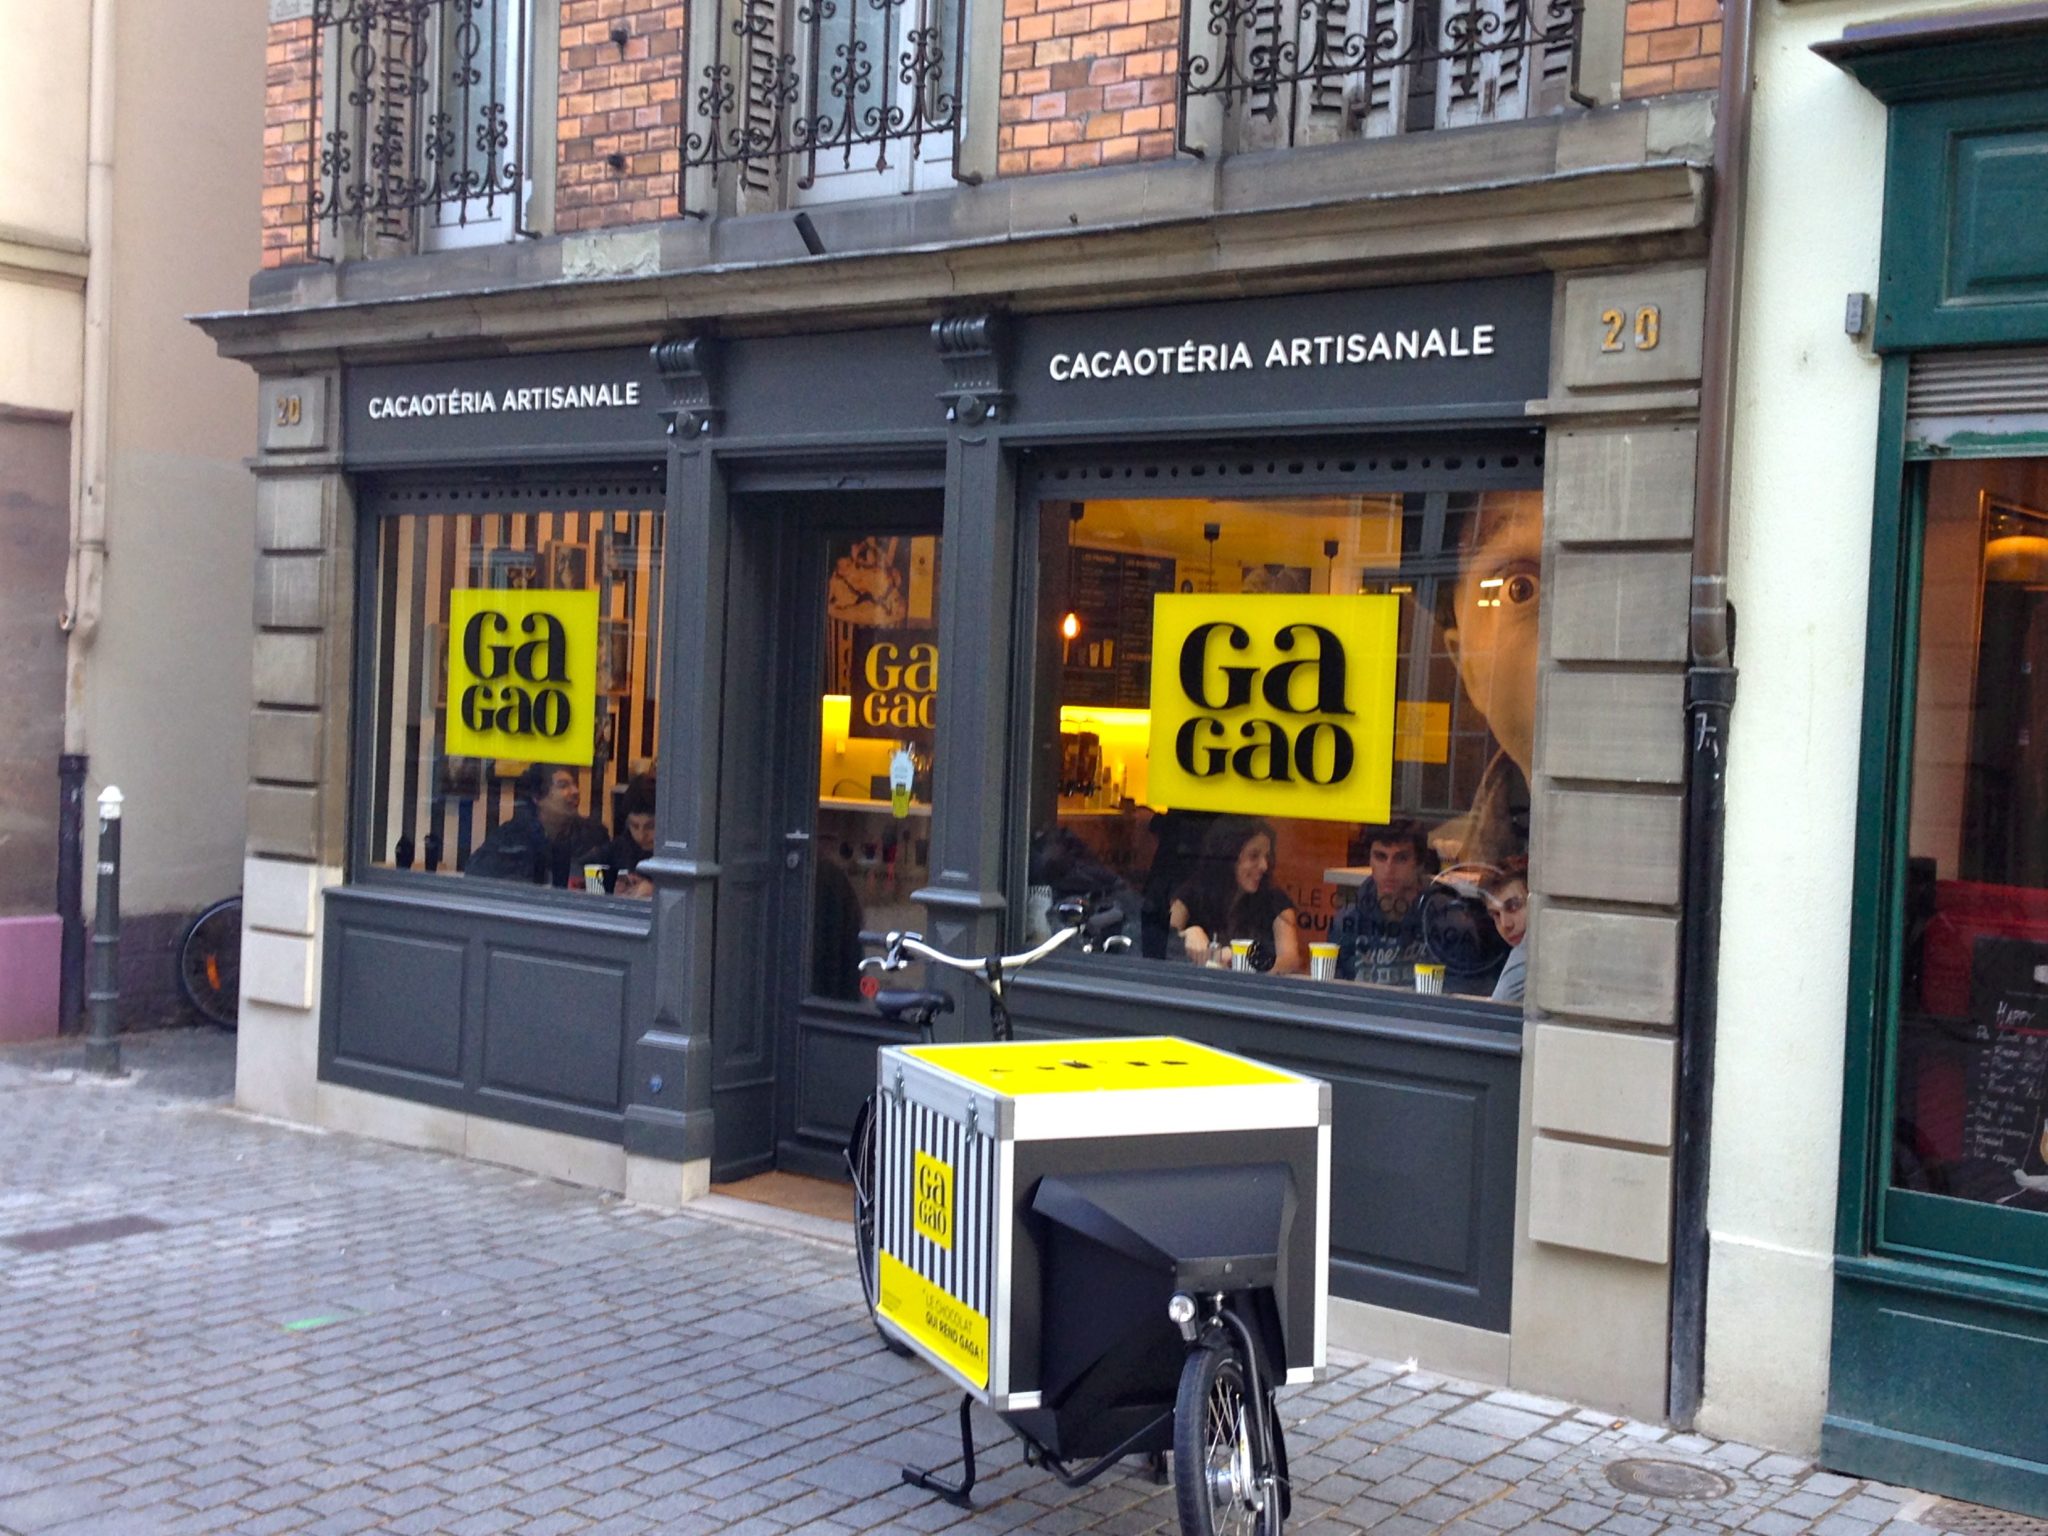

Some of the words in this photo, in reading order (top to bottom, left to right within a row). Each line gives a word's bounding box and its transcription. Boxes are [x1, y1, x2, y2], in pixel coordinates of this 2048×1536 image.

[1049, 340, 1254, 381] CACAOTÉRIA
[1265, 324, 1495, 368] ARTISANALE
[1601, 305, 1661, 353] 20
[275, 394, 302, 427] 20
[368, 388, 497, 419] CACAOTÉRIA
[502, 382, 641, 411] ARTISANALE
[463, 611, 571, 684] Ga
[1179, 622, 1356, 716] Ga
[461, 684, 571, 737] Gao
[1176, 716, 1354, 785] Gao
[1296, 911, 1334, 932] QUI
